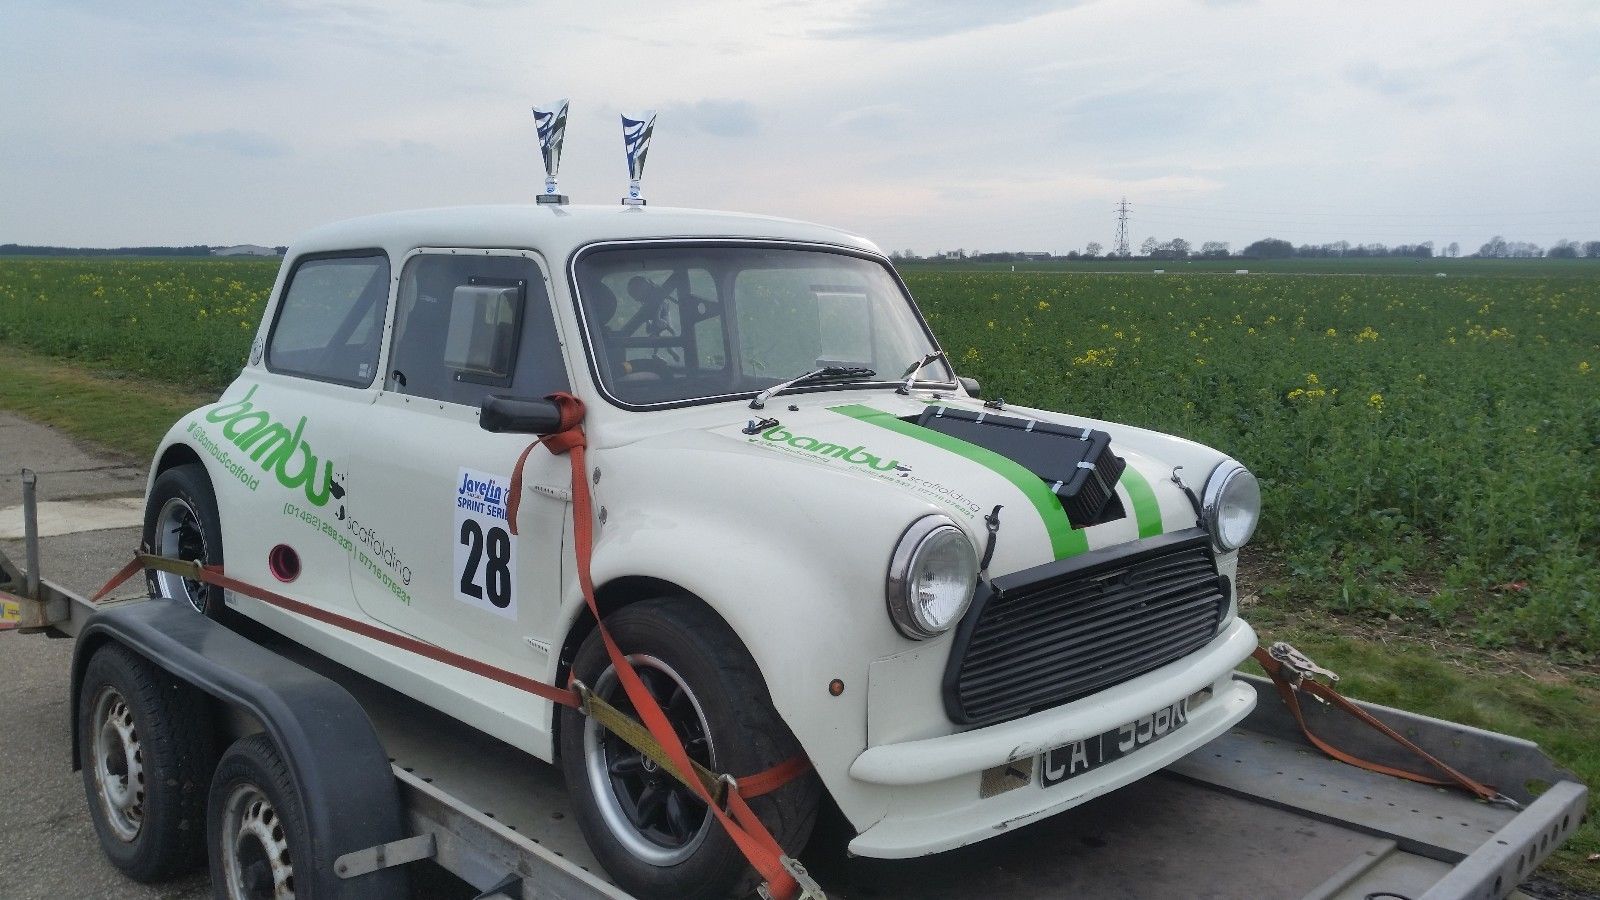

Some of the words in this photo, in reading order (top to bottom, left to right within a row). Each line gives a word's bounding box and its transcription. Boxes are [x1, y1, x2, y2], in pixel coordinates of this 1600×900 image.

[206, 384, 333, 507] bambu
[762, 425, 899, 471] bambu
[457, 496, 485, 514] SPRINT
[487, 504, 508, 520] SERI
[283, 502, 321, 531] (01482)
[322, 522, 338, 541] 298
[338, 537, 353, 552] 333
[359, 552, 382, 579] 07716
[382, 575, 411, 606] 076231
[347, 516, 412, 586] scaffolding
[460, 518, 511, 608] 28
